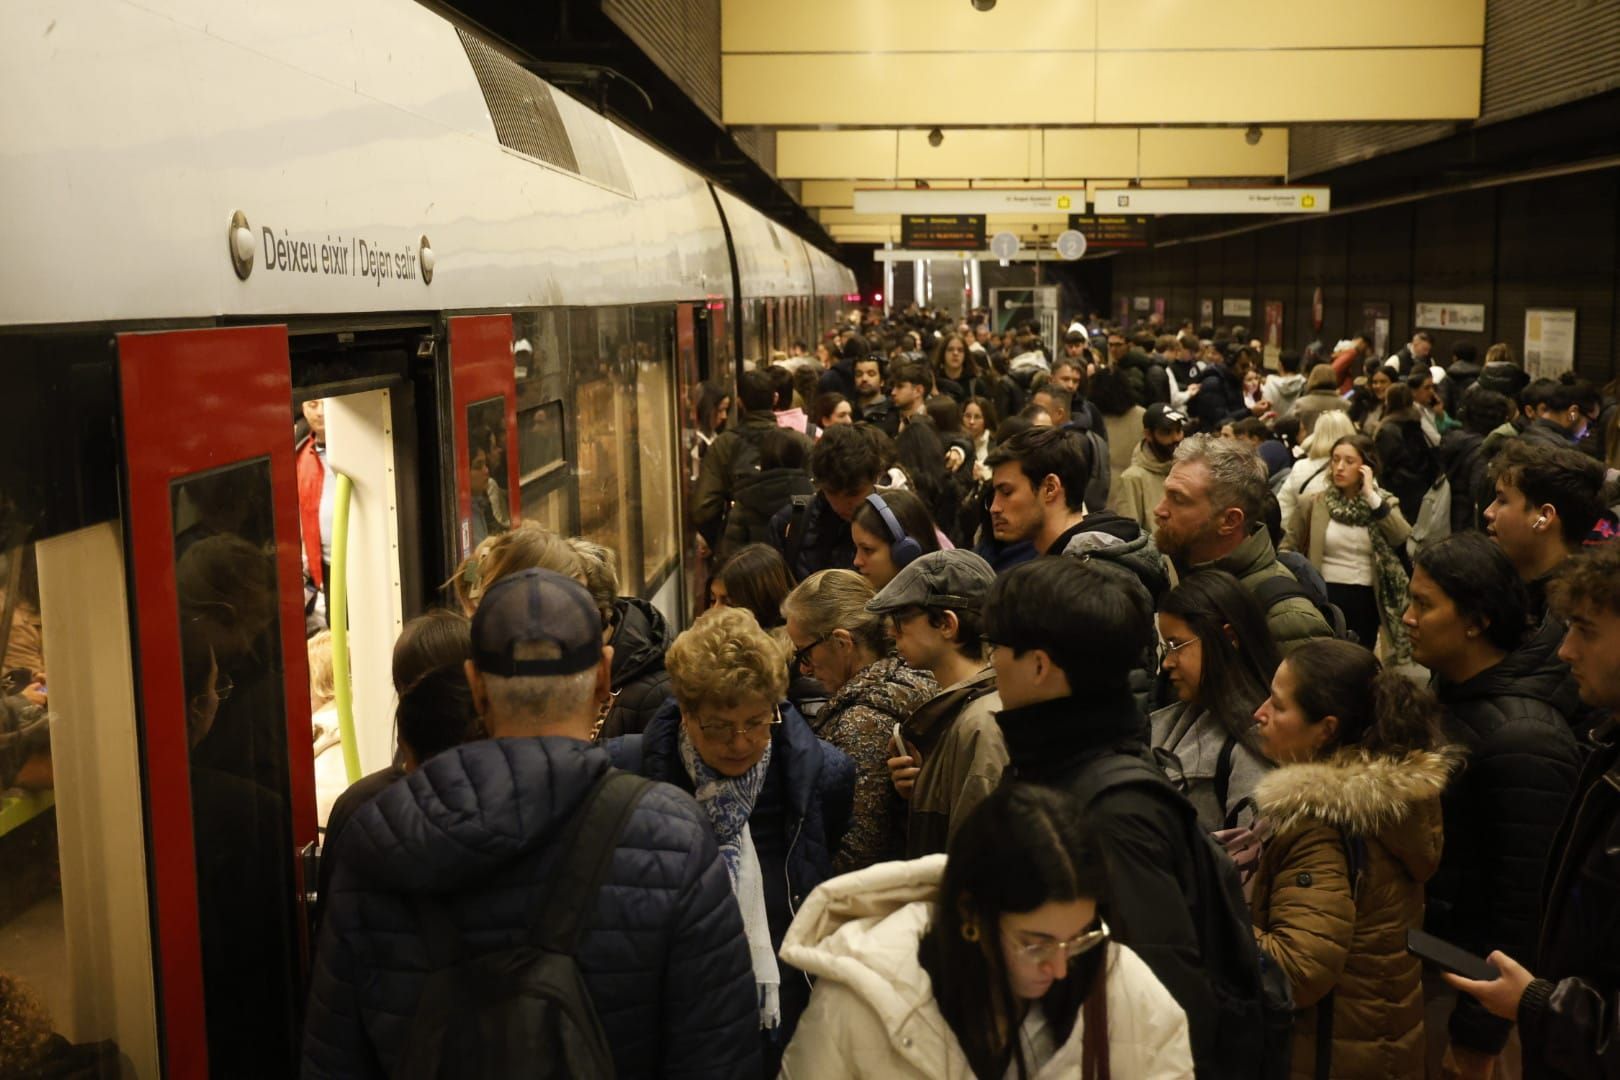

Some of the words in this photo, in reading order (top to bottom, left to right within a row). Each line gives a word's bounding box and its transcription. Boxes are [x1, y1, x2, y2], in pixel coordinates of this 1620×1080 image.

[262, 226, 318, 274] Deixeu
[322, 235, 348, 275] eixir
[359, 240, 393, 287] Dejen
[395, 246, 416, 280] salir
[1067, 241, 1077, 256] 2
